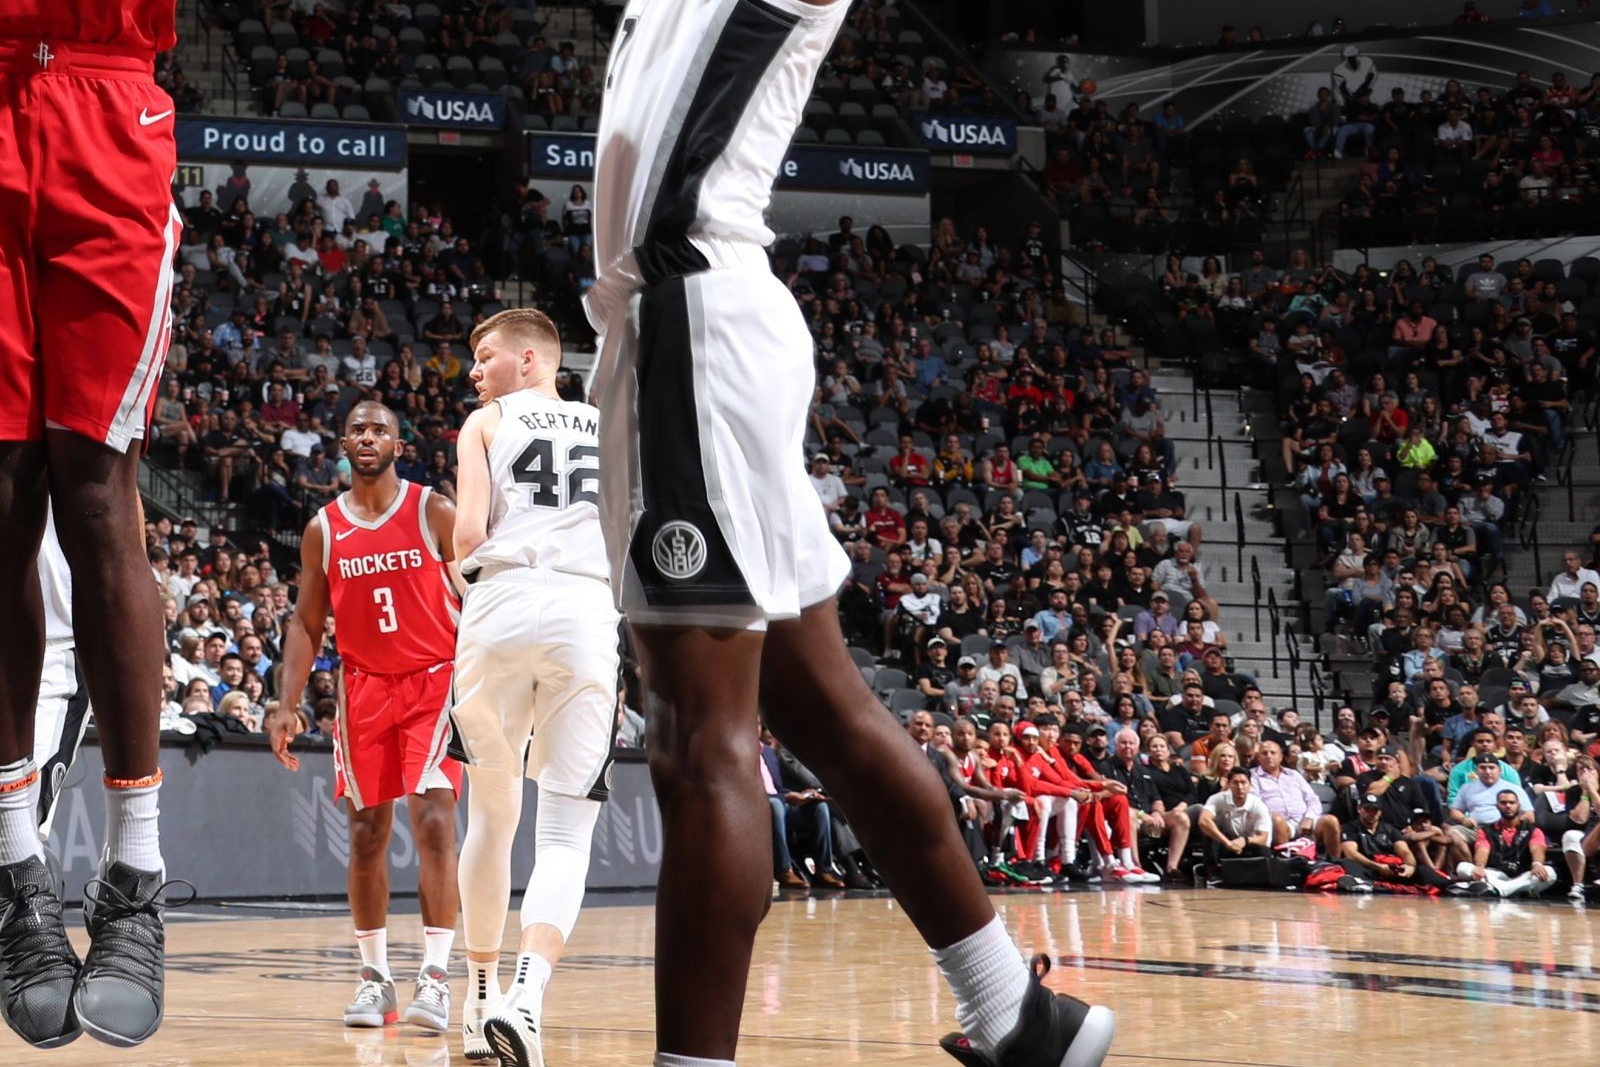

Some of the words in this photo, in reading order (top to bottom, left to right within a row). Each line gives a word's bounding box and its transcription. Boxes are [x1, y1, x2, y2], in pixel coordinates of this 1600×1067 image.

[436, 100, 494, 123] USAA
[204, 127, 286, 154] Proud
[299, 133, 325, 155] to
[337, 135, 386, 157] call
[950, 124, 1006, 145] USAA
[547, 144, 594, 168] San
[864, 161, 915, 181] USAA
[518, 412, 598, 436] BERTAN
[509, 437, 599, 508] 42
[337, 549, 422, 580] ROCKETS
[373, 587, 398, 633] 3
